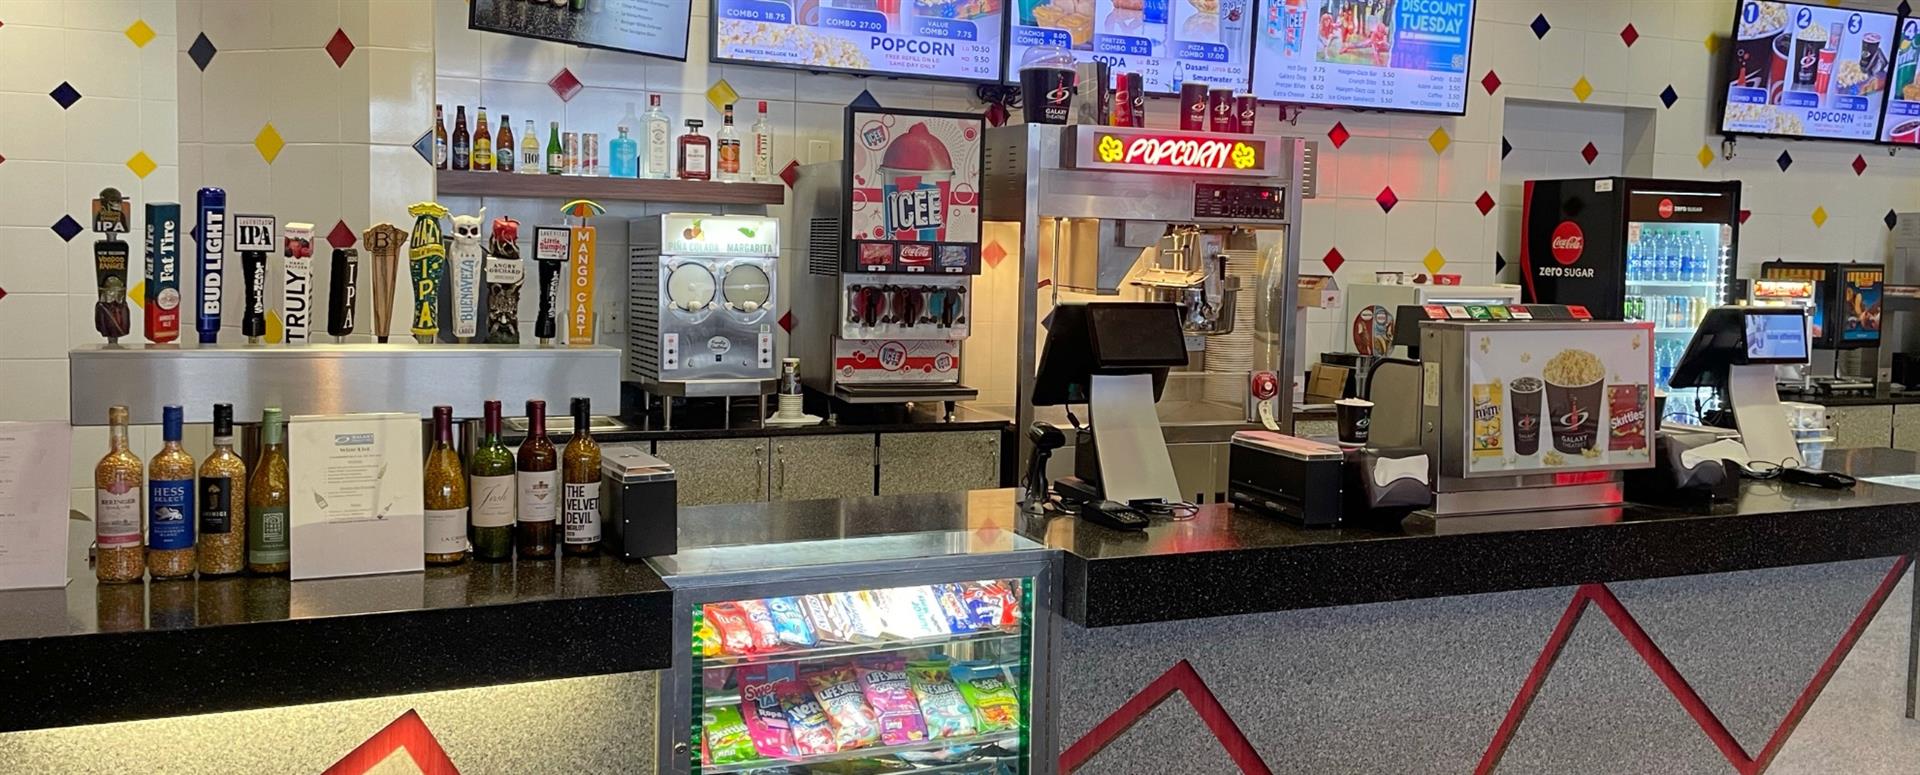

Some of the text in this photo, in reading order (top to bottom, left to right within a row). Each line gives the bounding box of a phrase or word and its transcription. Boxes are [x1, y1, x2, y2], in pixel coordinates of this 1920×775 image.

[727, 8, 785, 20] COMBO 18.75
[1401, 0, 1466, 16] DISCOUNT
[1748, 3, 1756, 20] 1
[826, 19, 882, 30] COMBO 27.00
[927, 20, 949, 28] VALUE
[1401, 14, 1463, 34] TUESDAY
[1800, 10, 1809, 26] 2
[1850, 15, 1860, 32] 3
[920, 27, 972, 39] COMBO 7.75
[1904, 22, 1914, 36] 4
[871, 36, 955, 56] POPCORN
[1018, 36, 1044, 44] COMBO
[971, 45, 990, 53] 10.50
[1101, 44, 1126, 52] COMBO
[1092, 55, 1126, 68] SODA
[1193, 74, 1232, 83] Smartwater
[1807, 110, 1854, 123] POPCORN
[1125, 138, 1232, 168] POPCORN
[888, 188, 944, 230] ICEE
[97, 221, 125, 232] IPA
[239, 226, 272, 246] IPA
[727, 243, 773, 254] MARGARITA
[1552, 236, 1582, 251] Coca-Cola
[160, 220, 175, 282] Fat Tire
[204, 211, 223, 314] BUD LIGHT
[1539, 264, 1594, 278] zero SUGAR
[253, 262, 264, 314] LAGUNITAS
[576, 232, 590, 335] MANGO CART
[343, 264, 355, 328] IPA
[418, 259, 434, 328] IPA
[460, 260, 475, 322] BUENAVEZA
[286, 270, 306, 344] TRULY
[1611, 410, 1644, 429] Skittles
[154, 486, 184, 496] HESS
[567, 486, 584, 498] THE
[567, 498, 598, 510] VELVET
[567, 512, 592, 524] DEVIL
[867, 673, 884, 684] LIFE
[820, 688, 837, 700] LIFE
